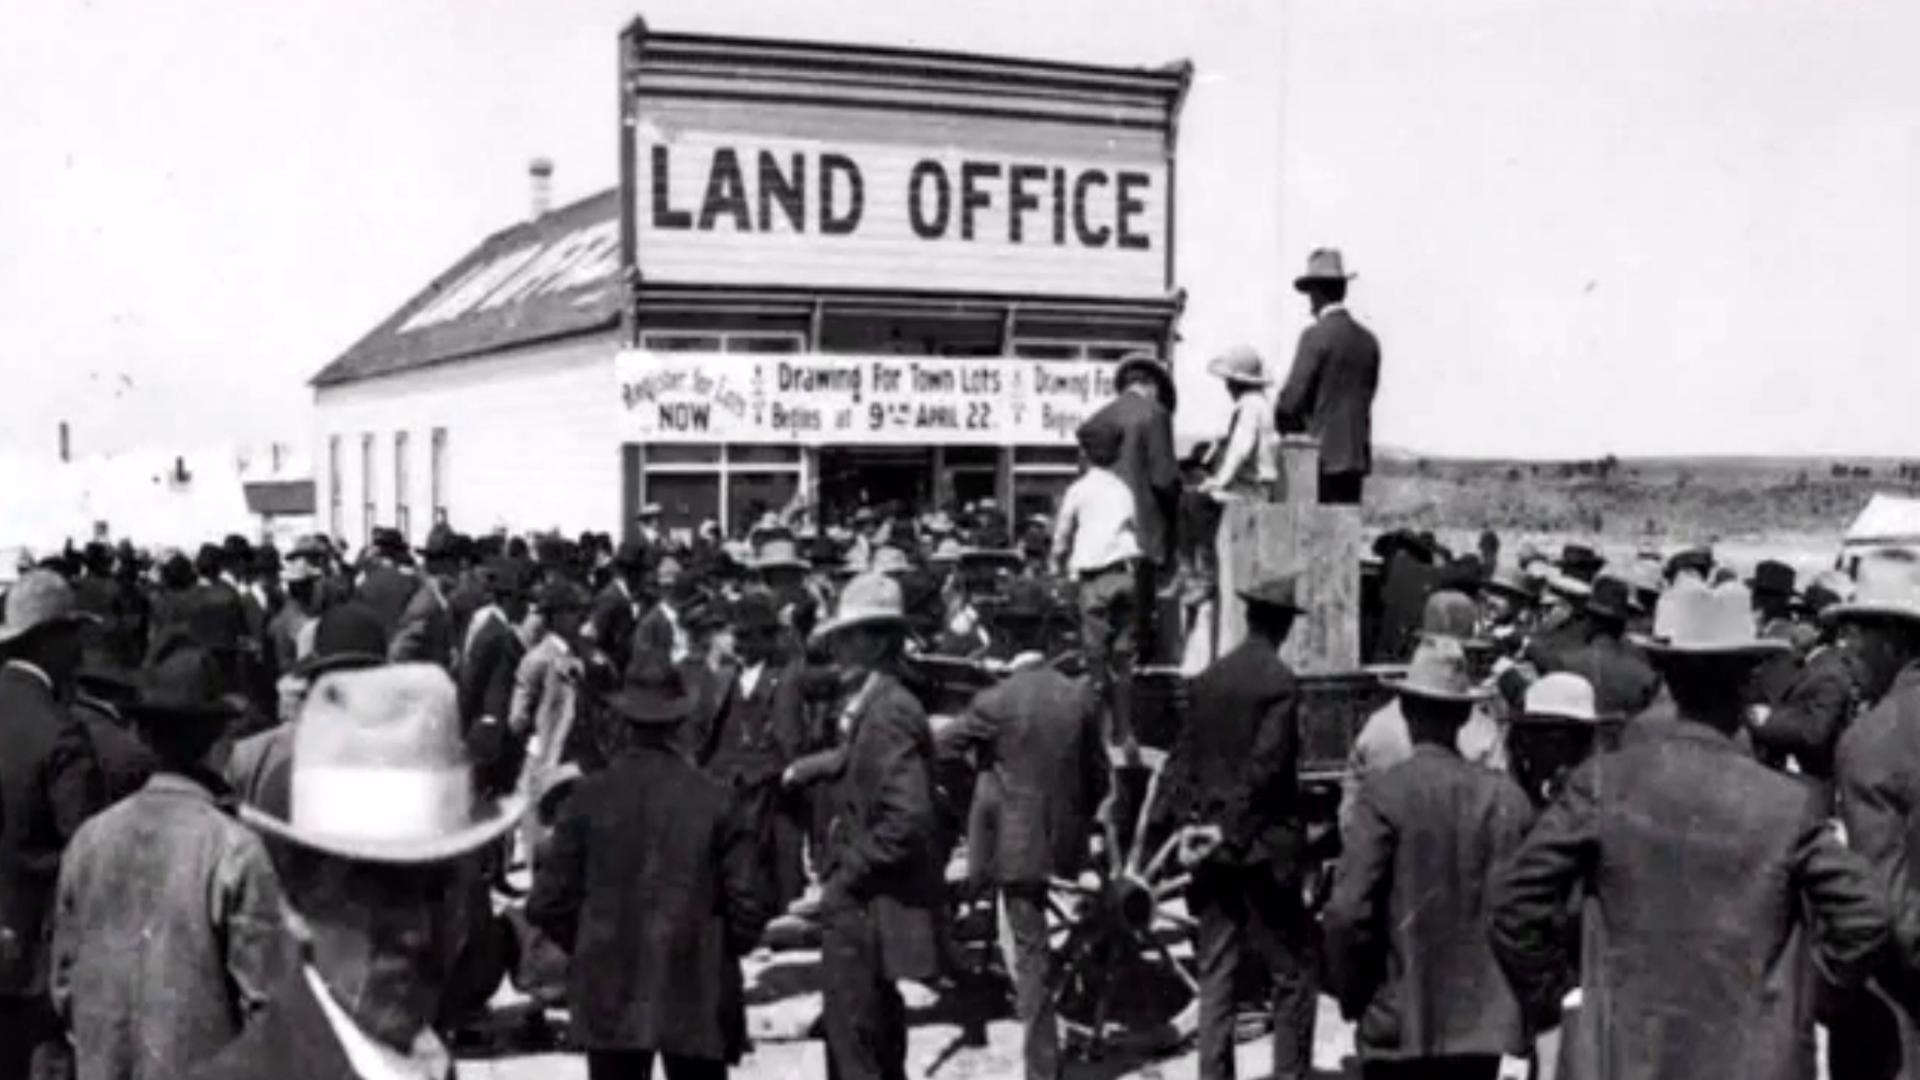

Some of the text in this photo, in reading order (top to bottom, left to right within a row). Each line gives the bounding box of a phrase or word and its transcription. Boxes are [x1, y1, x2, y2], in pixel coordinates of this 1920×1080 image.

[651, 144, 1151, 249] LAND OFFICE
[778, 362, 1001, 403] Drawing For Town Lots
[658, 402, 710, 431] NOW
[771, 402, 821, 439] Begins
